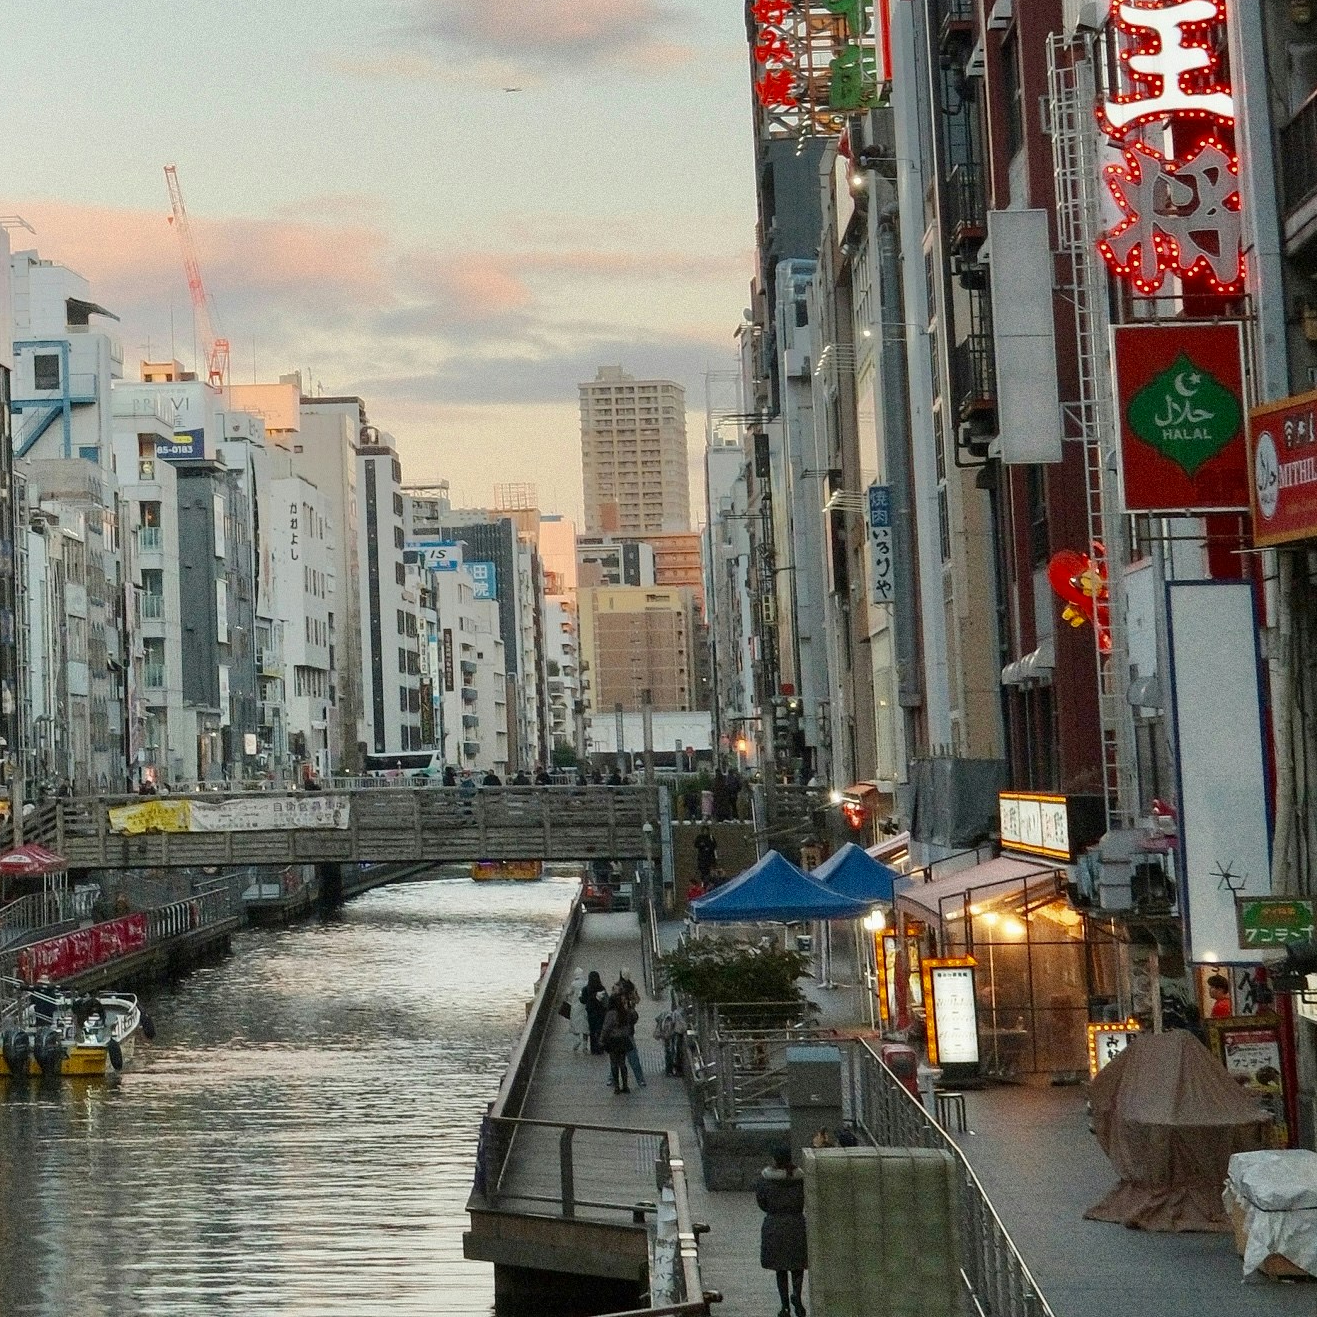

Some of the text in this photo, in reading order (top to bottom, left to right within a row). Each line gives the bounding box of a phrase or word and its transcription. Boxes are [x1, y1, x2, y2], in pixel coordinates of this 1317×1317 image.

[132, 397, 189, 411] BRVI
[1155, 394, 1215, 427] حلال
[1162, 429, 1212, 440] HALAL
[871, 490, 888, 524] 焼肉
[872, 529, 892, 599] いろりや
